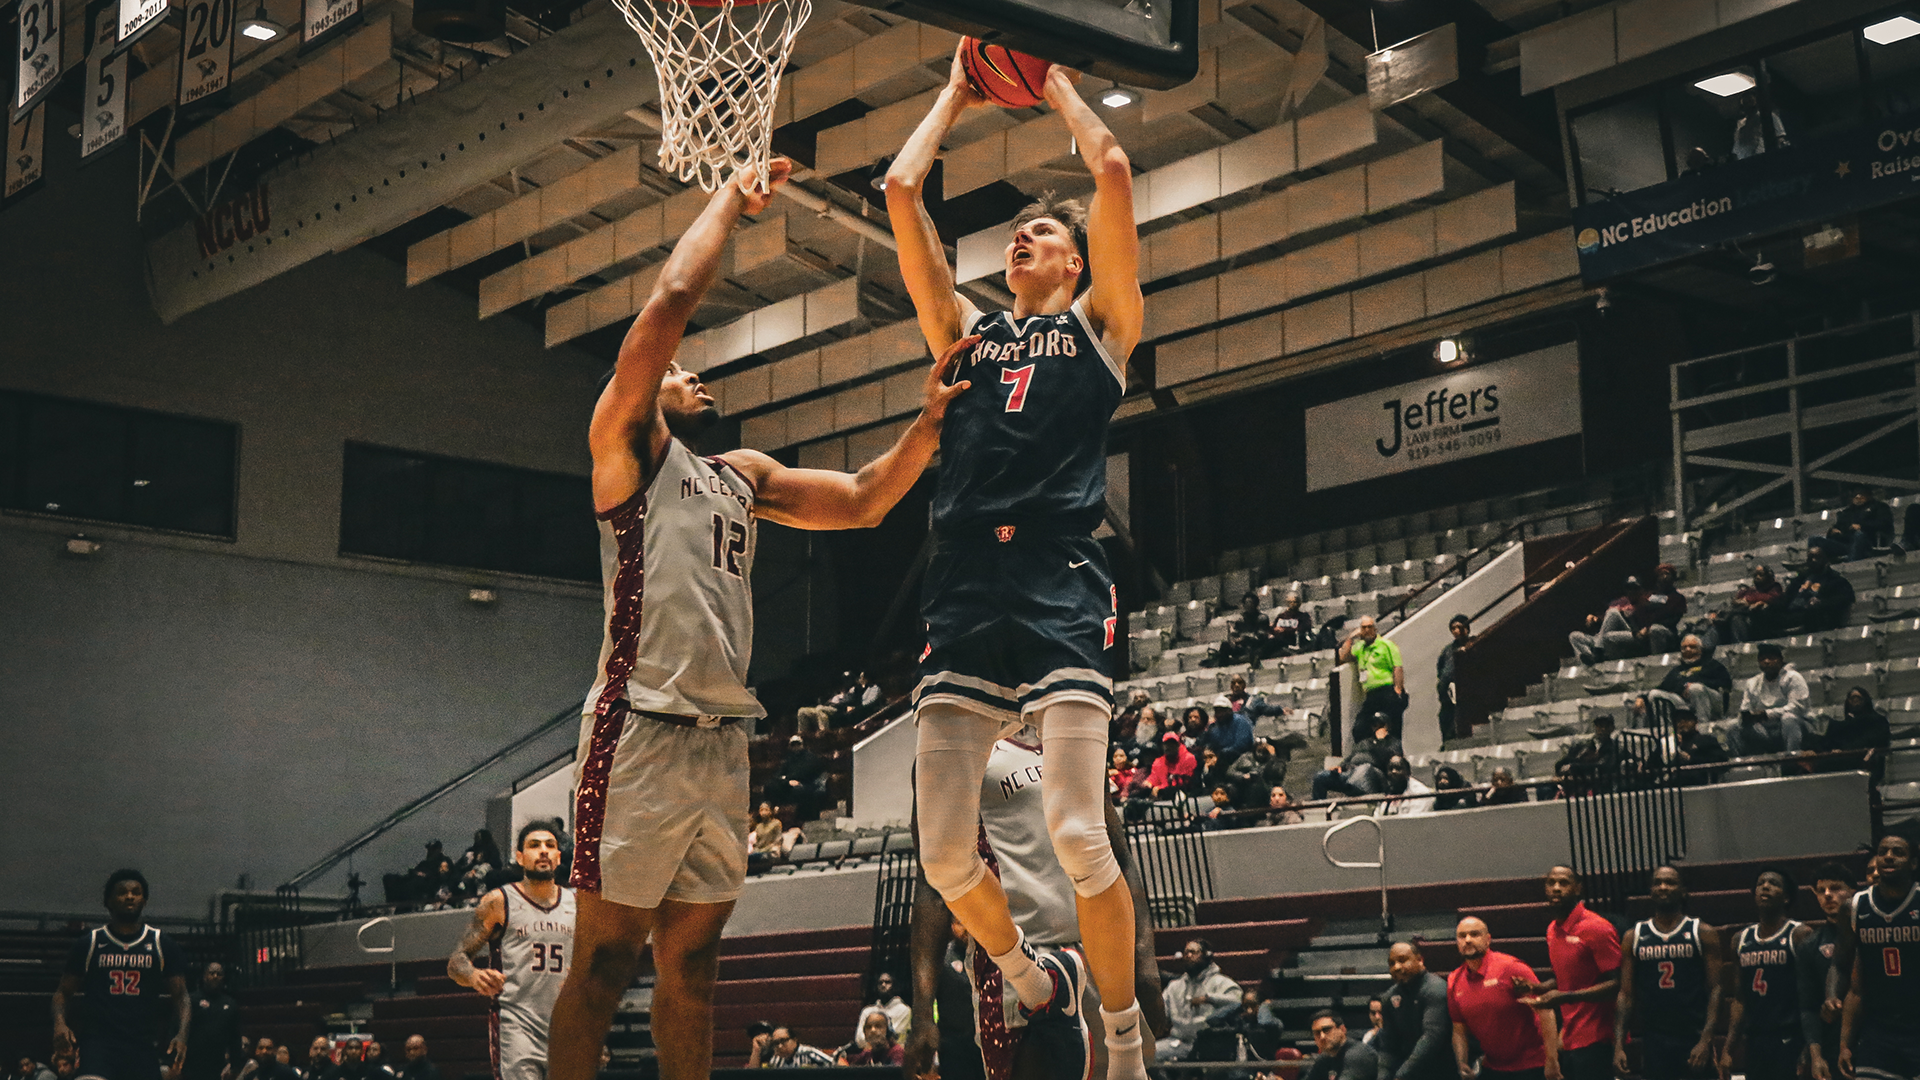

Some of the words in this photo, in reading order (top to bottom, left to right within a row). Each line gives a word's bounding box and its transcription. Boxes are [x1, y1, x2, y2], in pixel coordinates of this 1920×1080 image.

[22, 0, 58, 61] 31
[124, 0, 163, 35] 2009-2011
[187, 0, 231, 60] 20
[97, 56, 114, 107] 5
[194, 180, 271, 259] NCCU
[1601, 222, 1629, 248] NC
[1631, 196, 1733, 239] Education
[970, 329, 1077, 367] RADFORD
[1000, 363, 1036, 413] 7
[1376, 384, 1500, 457] Jeffers
[1405, 430, 1431, 447] LAW
[1432, 424, 1460, 439] FIRM
[681, 476, 704, 500] NC
[711, 510, 749, 580] 12
[999, 770, 1025, 801] NC
[1859, 925, 1920, 944] RADFORD
[98, 953, 153, 968] RADFORD
[531, 942, 564, 974] 35
[1639, 943, 1694, 961] RADFORD
[1882, 947, 1902, 977] 0
[109, 970, 141, 995] 32
[1657, 961, 1675, 989] 2
[1752, 967, 1768, 996] 4
